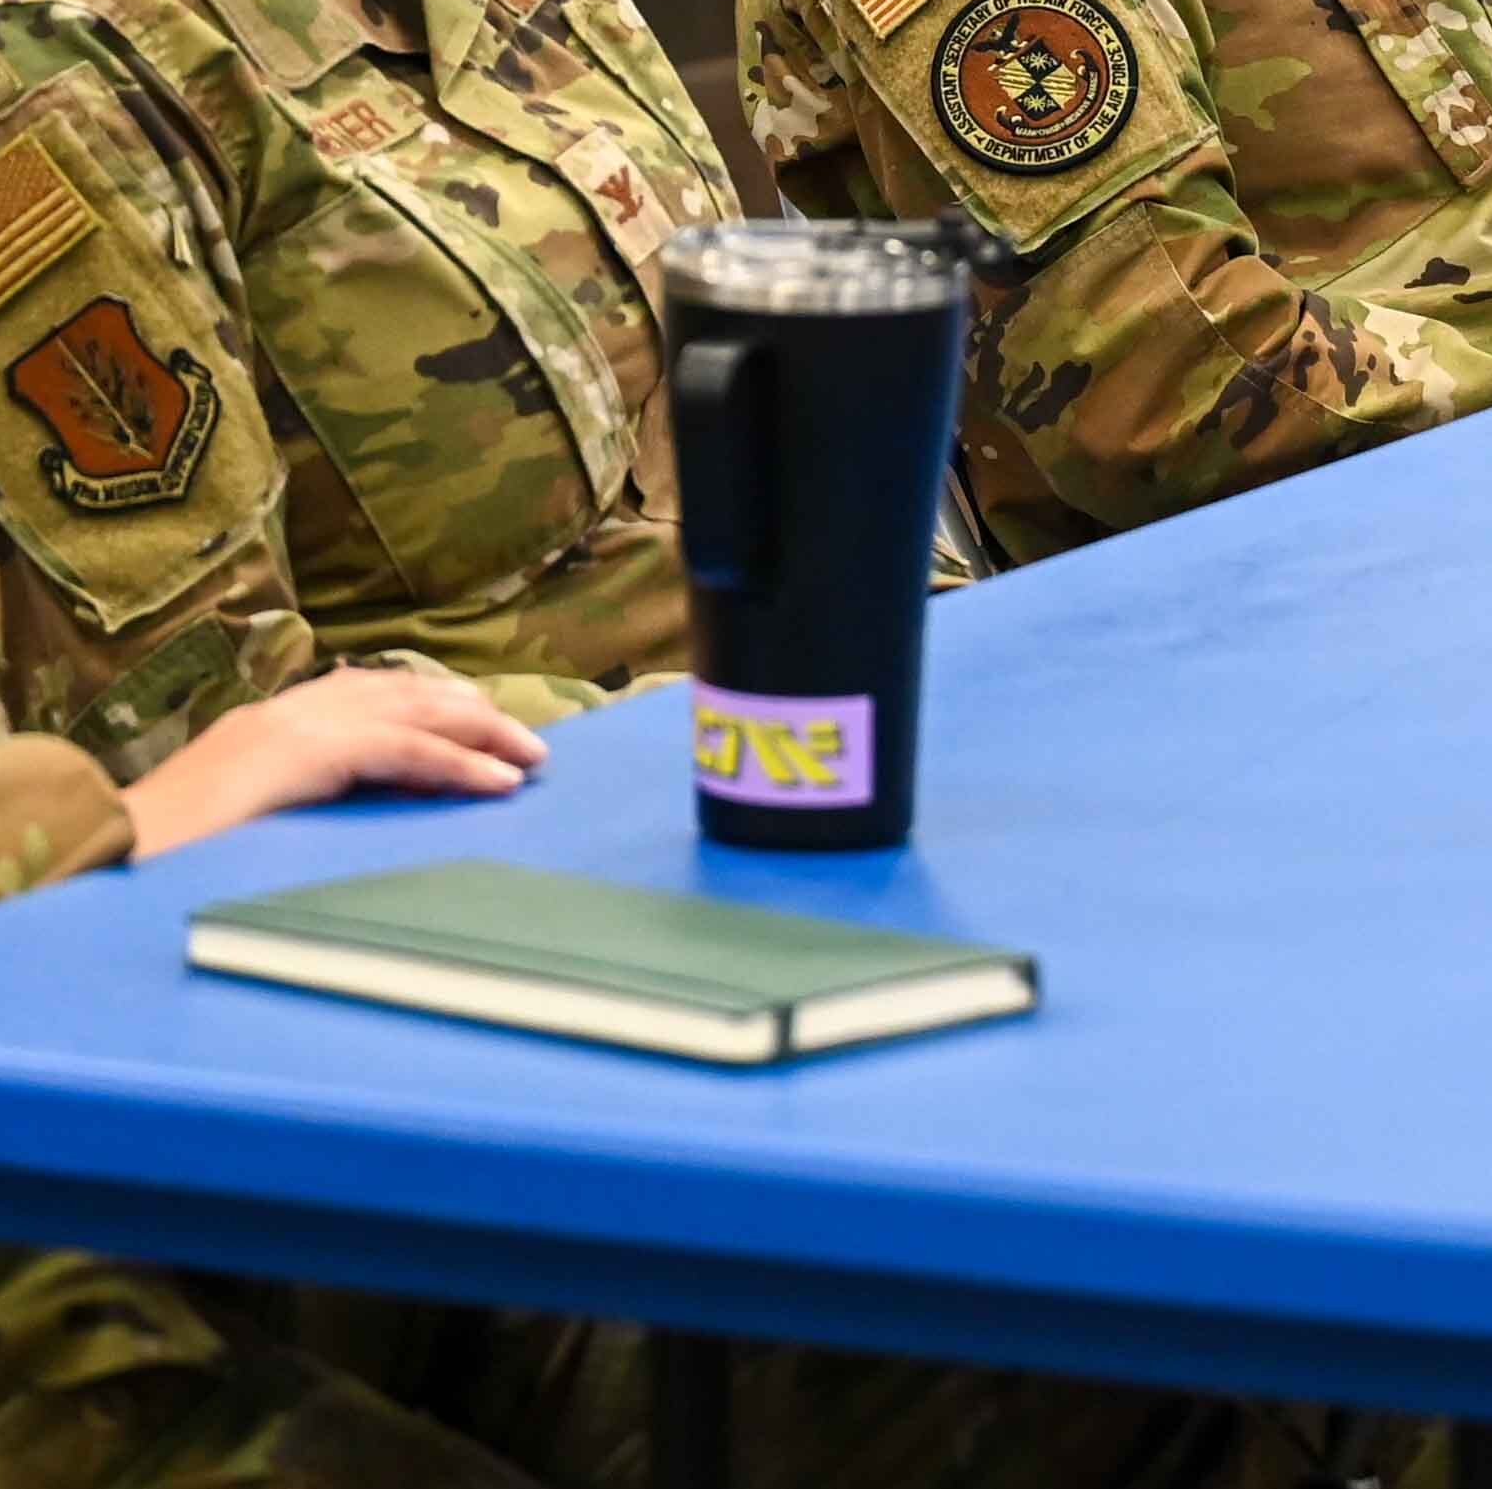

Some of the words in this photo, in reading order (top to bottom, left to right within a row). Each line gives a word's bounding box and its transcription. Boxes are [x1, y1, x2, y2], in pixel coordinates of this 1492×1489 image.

[1069, 0, 1108, 34] FORCE
[944, 5, 992, 68] SECRETARY
[1111, 41, 1127, 88] FORCE
[942, 71, 976, 136] ASSISTANT
[1110, 89, 1125, 112] AIR
[1090, 108, 1116, 135] THE
[983, 139, 1073, 163] DEPARTMENT
[1075, 130, 1092, 149] OF
